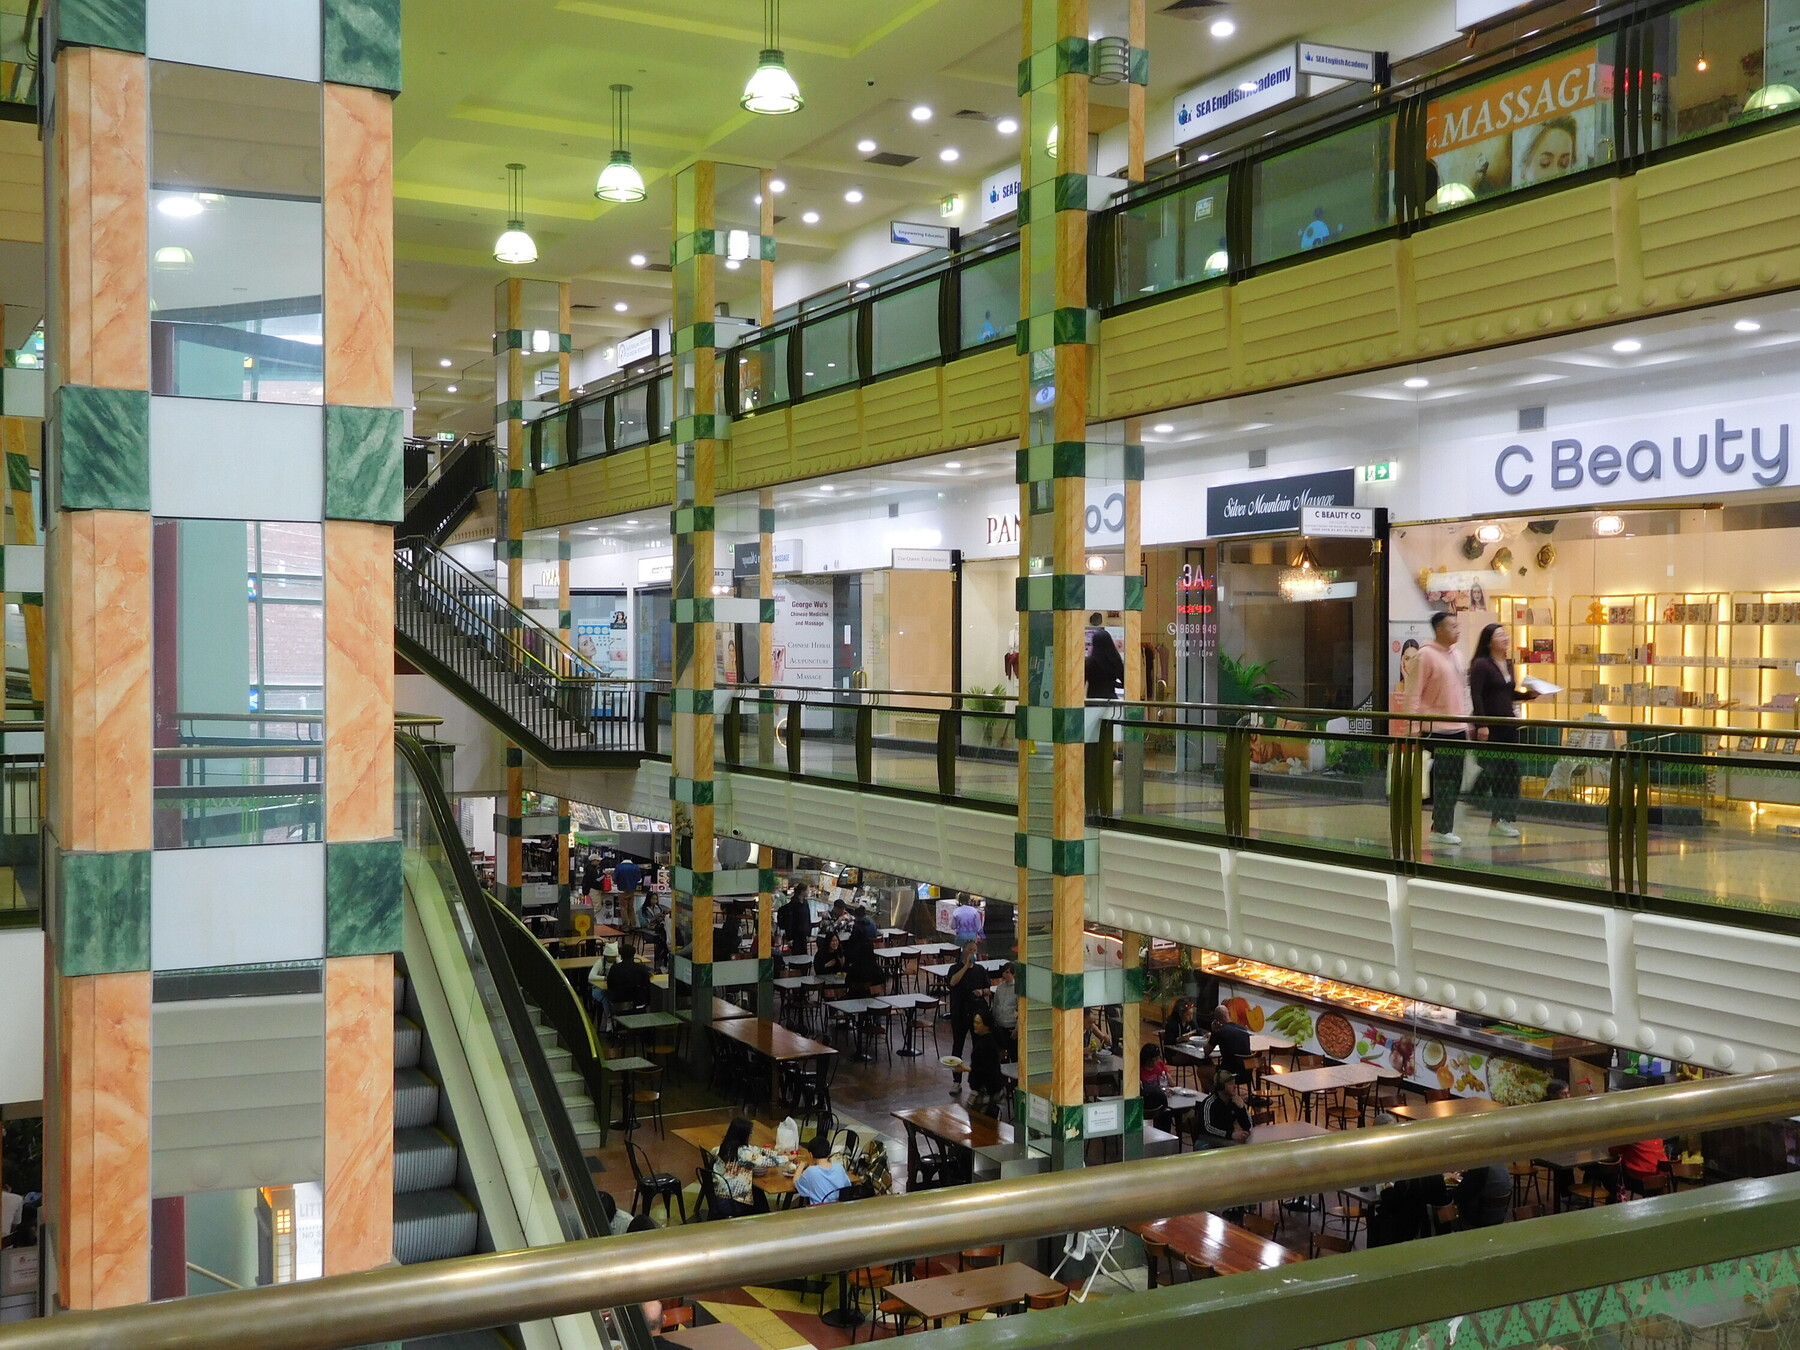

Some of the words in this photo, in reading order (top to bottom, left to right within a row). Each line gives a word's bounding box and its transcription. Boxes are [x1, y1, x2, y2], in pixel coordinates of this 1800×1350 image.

[1315, 55, 1325, 64] SEA
[1325, 56, 1345, 67] English
[1345, 59, 1369, 70] Academy
[1196, 101, 1212, 119] SEA
[1002, 184, 1014, 199] SEA
[1495, 444, 1534, 494] C
[1551, 418, 1789, 488] Beauty
[1223, 497, 1246, 518] Silver
[1248, 493, 1291, 516] Mountain
[1321, 511, 1349, 520] BEAUTY
[1183, 563, 1205, 587] 3A
[791, 601, 812, 609] George
[813, 600, 828, 608] Wu's
[804, 620, 824, 628] Massage
[796, 672, 822, 681] MASSAGE
